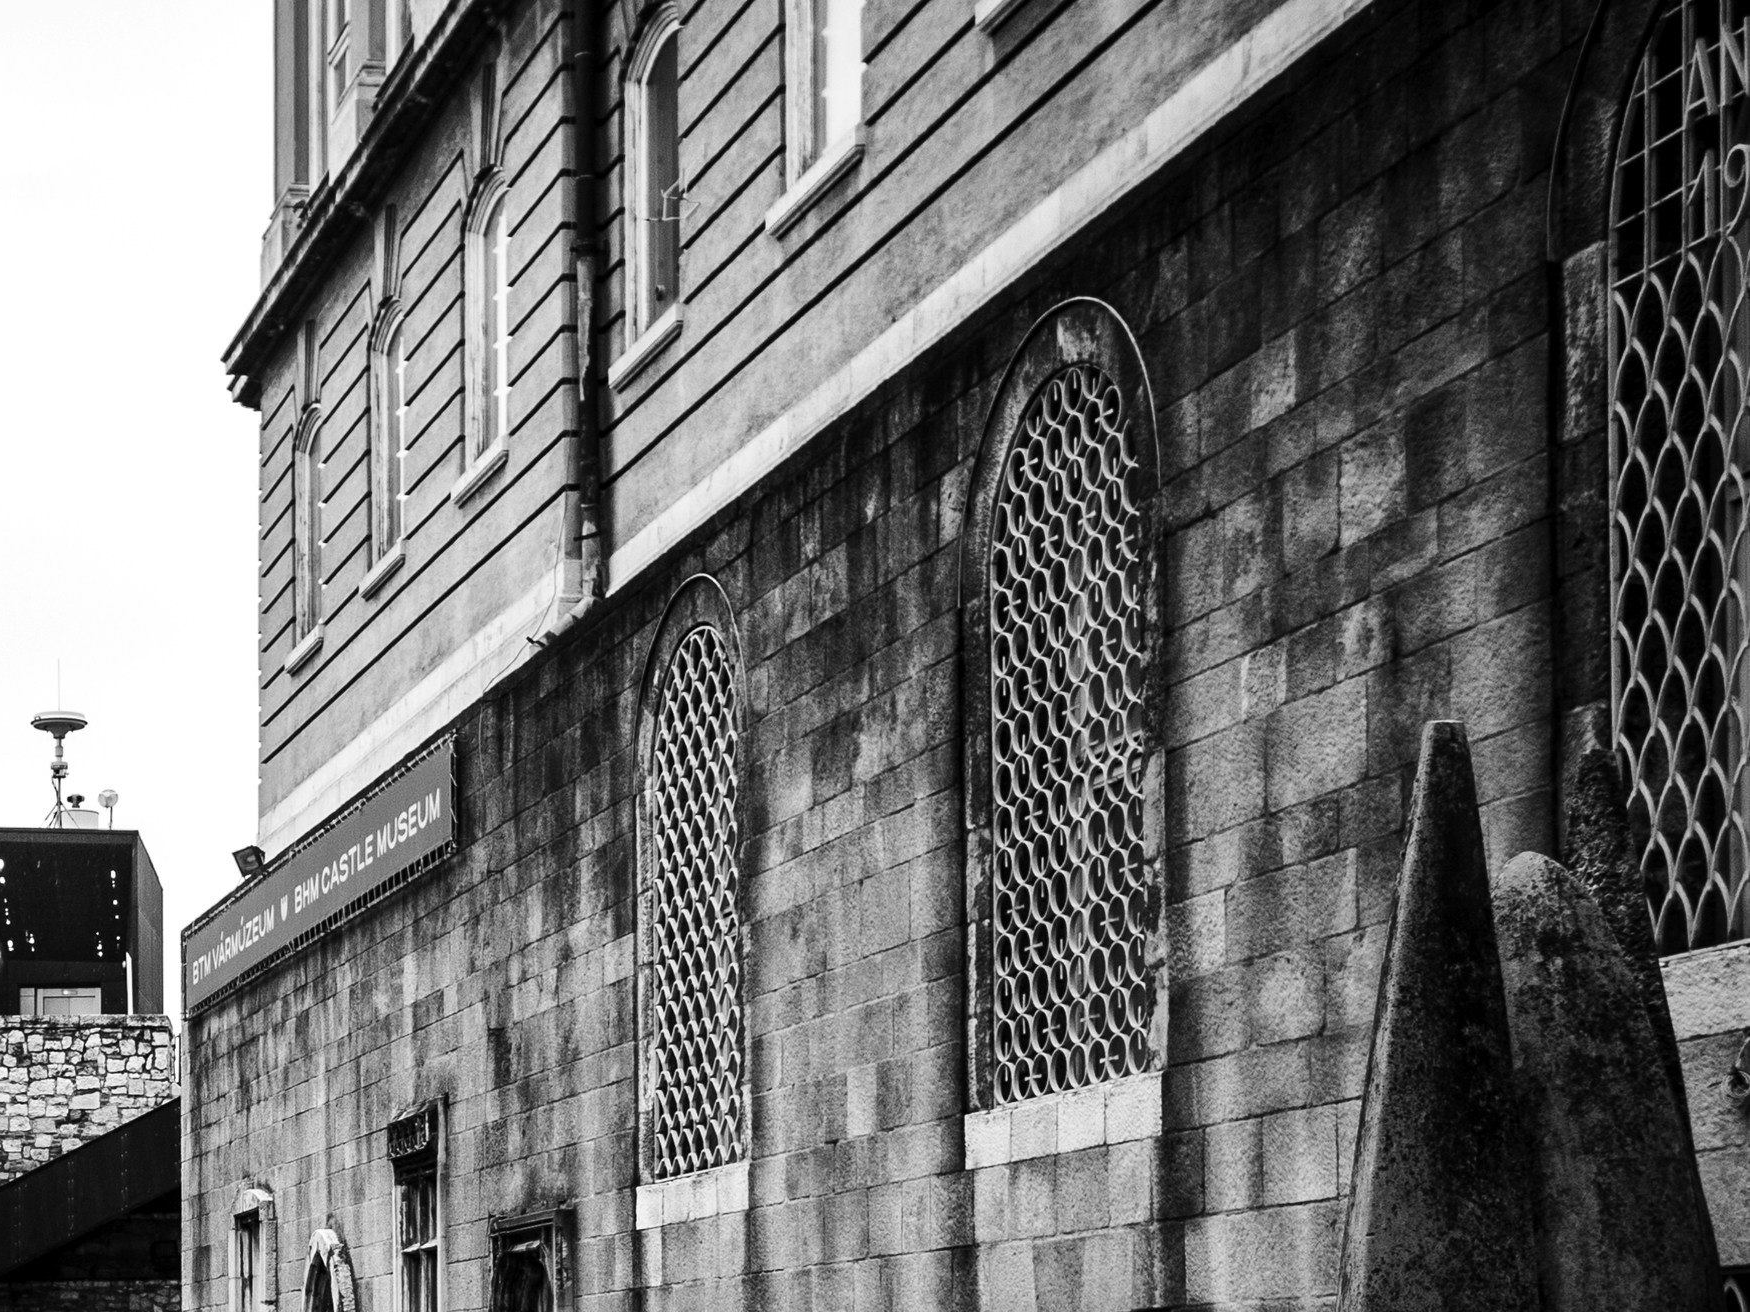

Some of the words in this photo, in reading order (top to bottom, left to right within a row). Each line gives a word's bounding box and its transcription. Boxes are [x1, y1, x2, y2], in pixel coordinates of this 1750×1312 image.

[192, 952, 211, 985] BTM
[211, 904, 275, 969] VÁRMÚZEUM
[295, 873, 320, 914] BHM
[320, 834, 374, 895] CASTLE
[376, 788, 441, 858] MUSEUM
